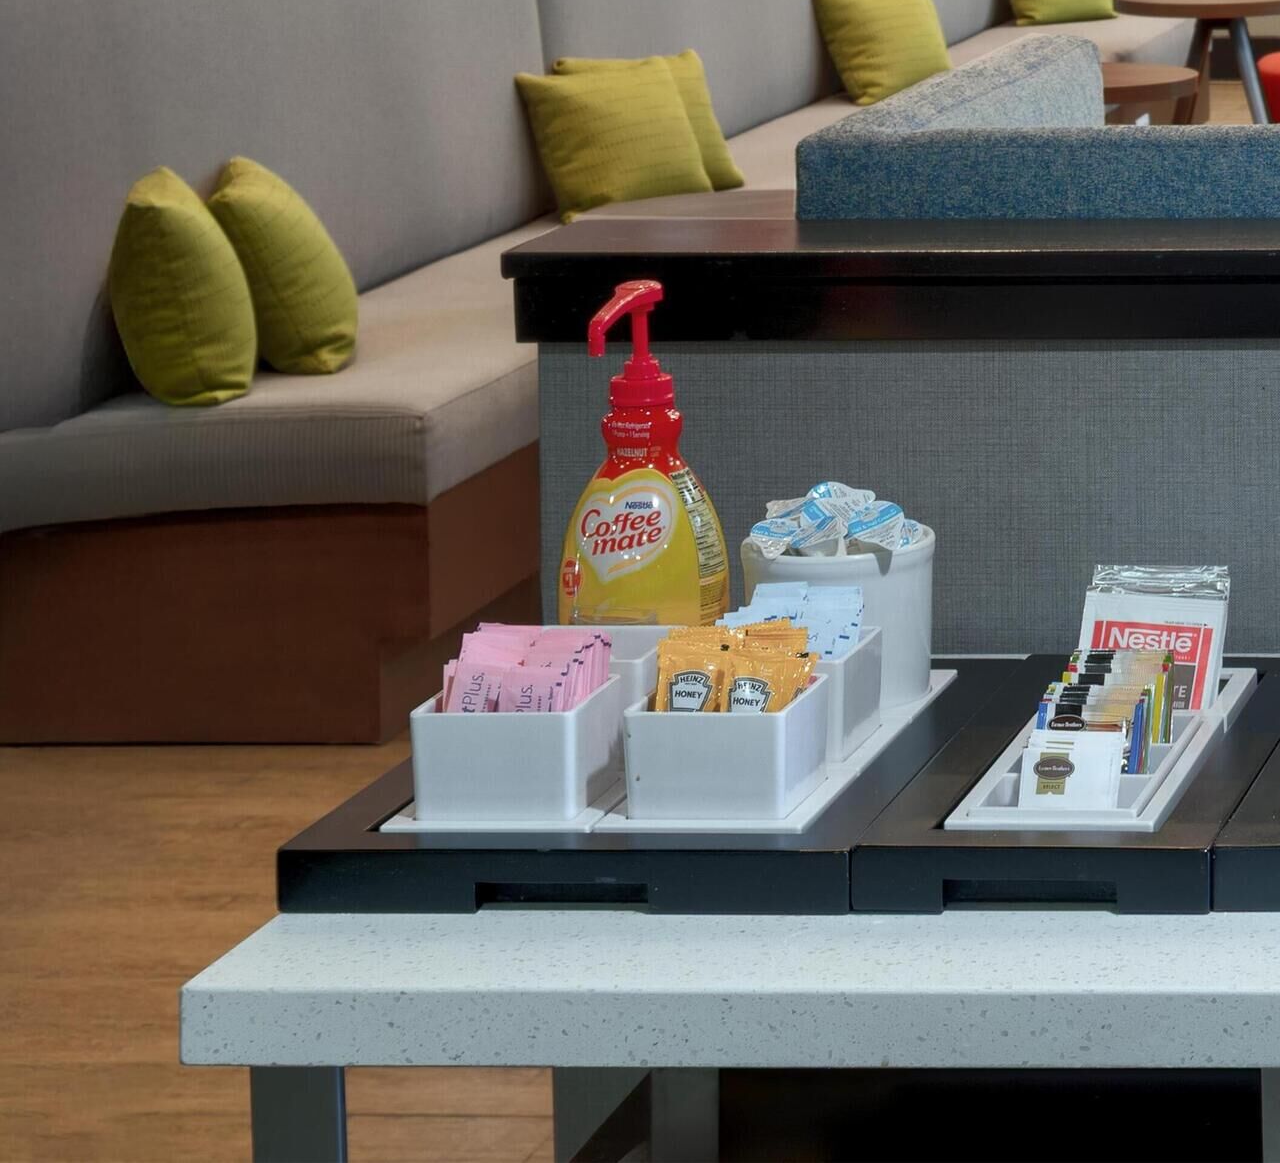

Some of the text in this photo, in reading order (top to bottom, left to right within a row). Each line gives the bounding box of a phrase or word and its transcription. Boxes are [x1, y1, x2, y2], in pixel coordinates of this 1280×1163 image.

[580, 508, 662, 539] Coffee
[591, 526, 663, 556] mate
[1108, 625, 1194, 654] Nestlé
[679, 673, 704, 685] HEINZ
[736, 680, 762, 692] HEINZ
[674, 689, 703, 700] HONEY
[732, 697, 761, 708] HONEY
